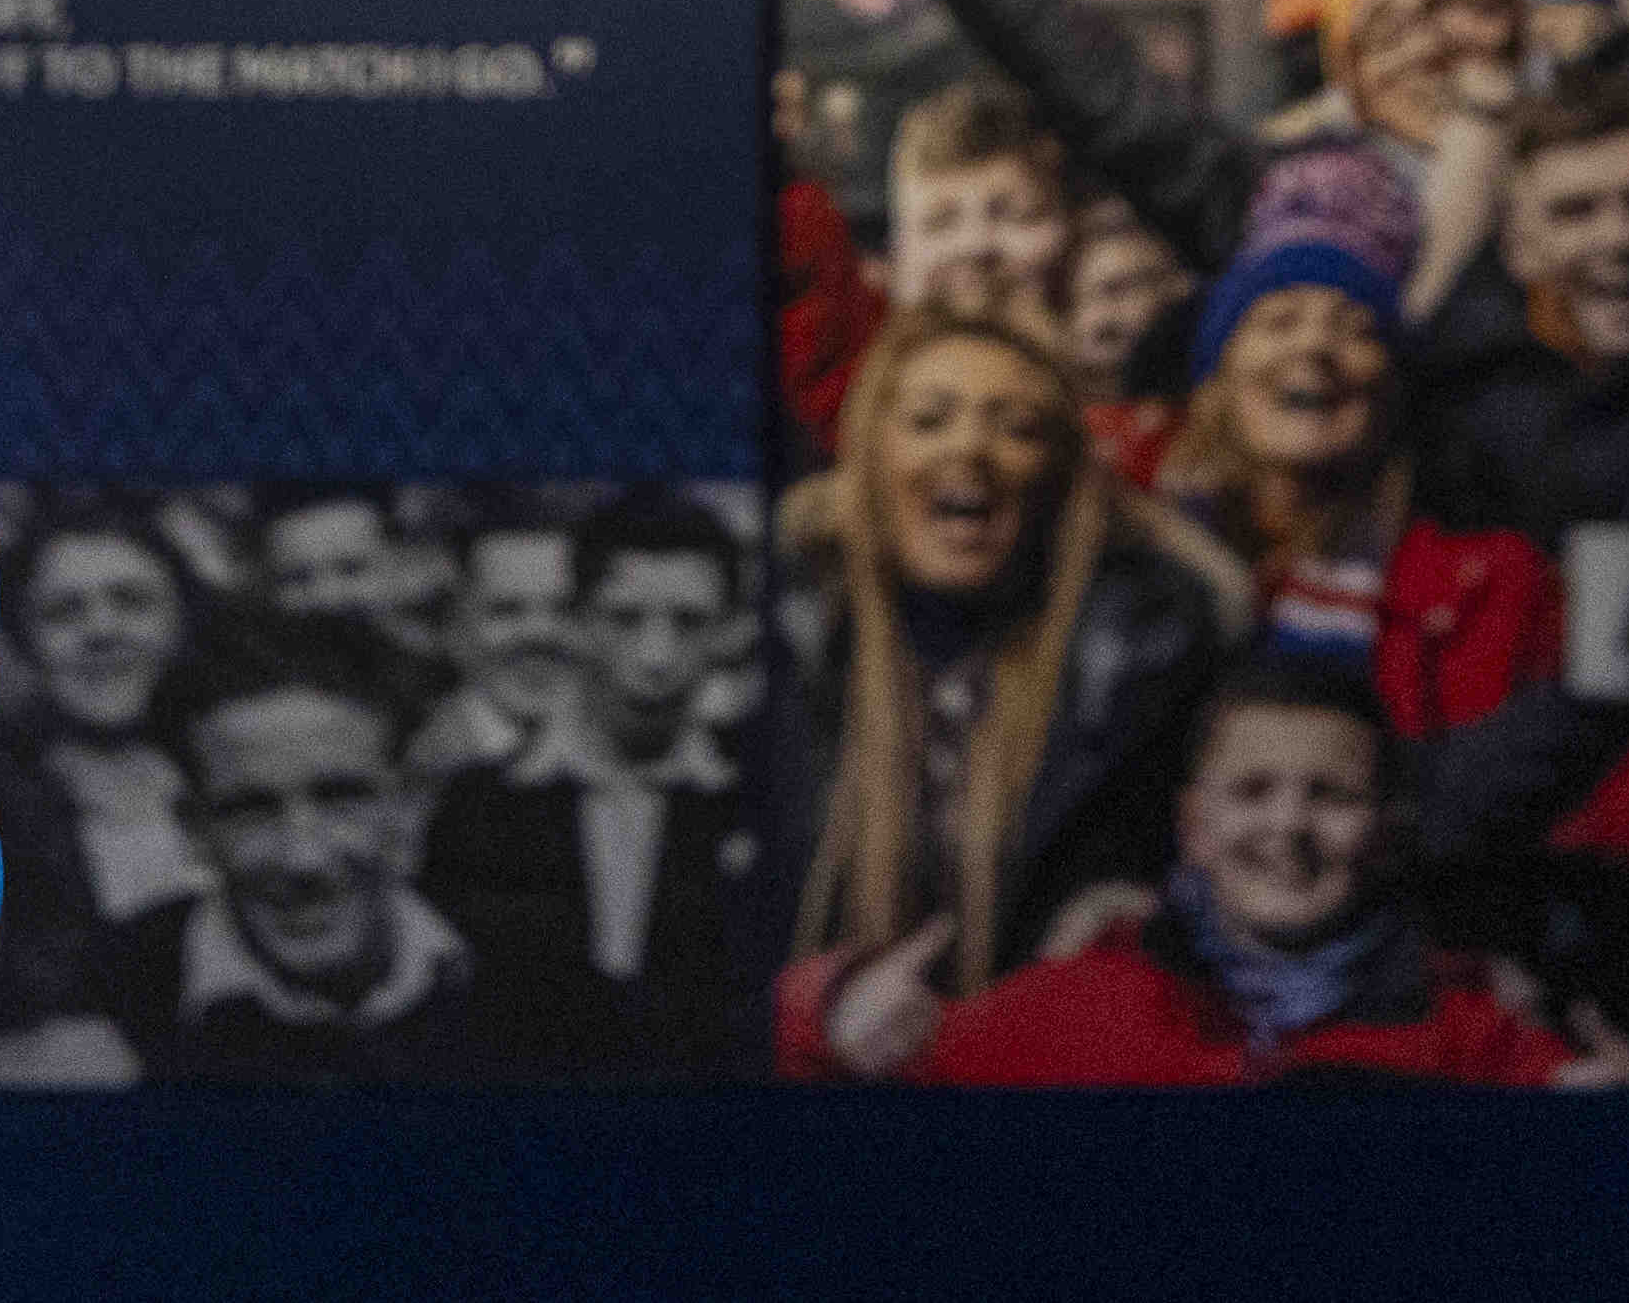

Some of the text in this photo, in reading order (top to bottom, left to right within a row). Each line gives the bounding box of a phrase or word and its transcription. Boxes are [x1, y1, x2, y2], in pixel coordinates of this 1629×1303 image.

[42, 42, 119, 97] TO
[123, 42, 224, 96] THE
[229, 42, 415, 96] MATCH
